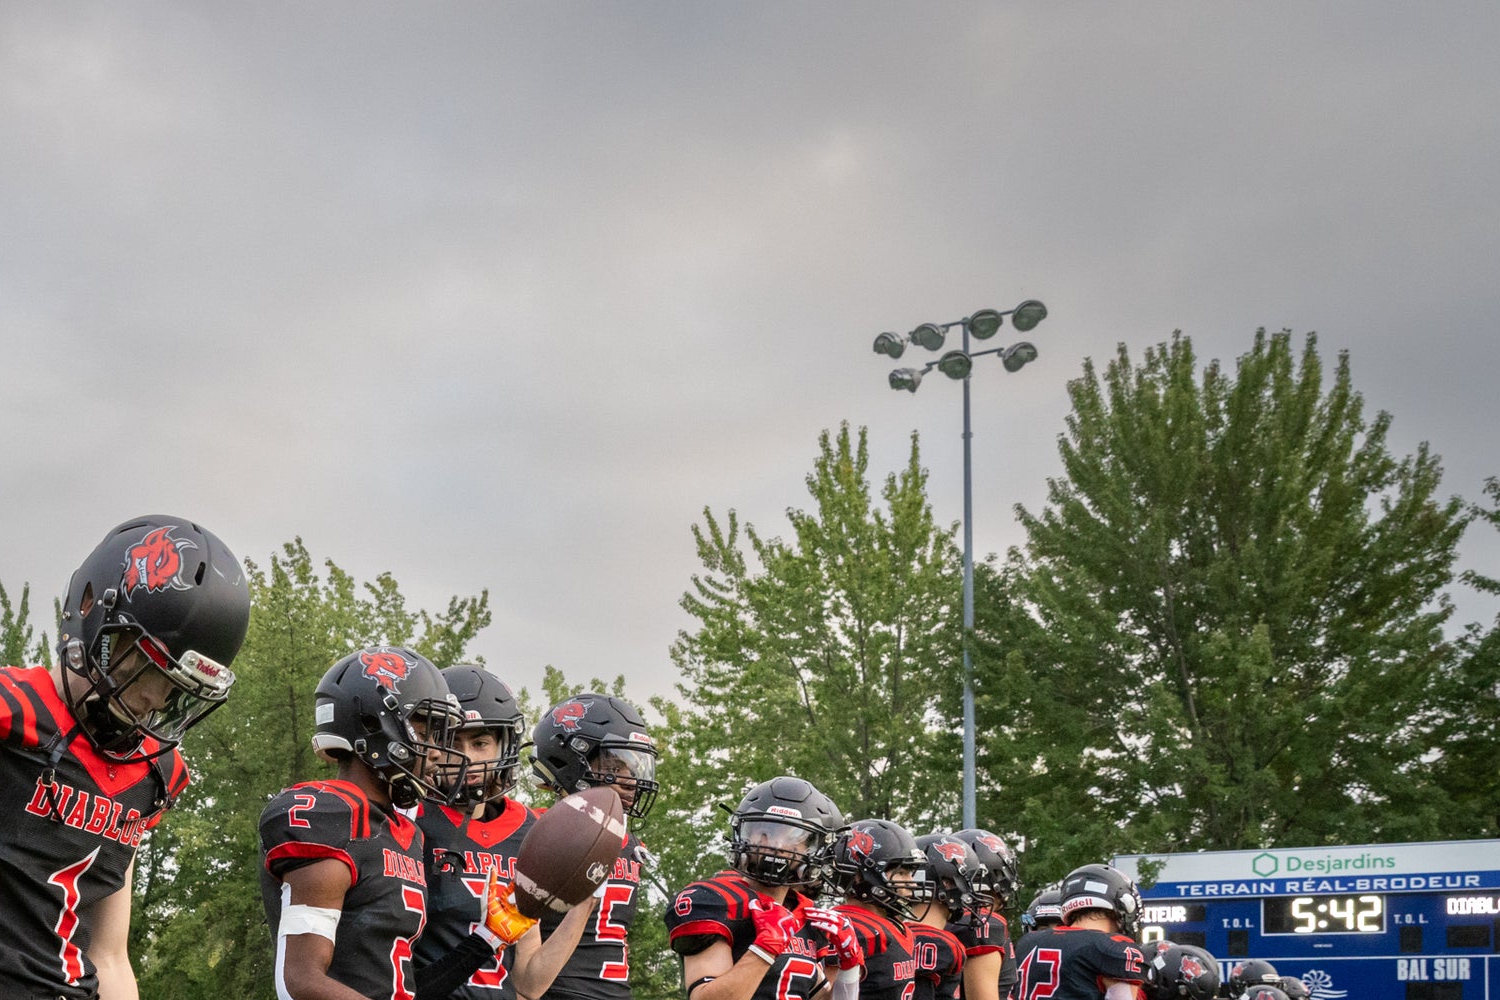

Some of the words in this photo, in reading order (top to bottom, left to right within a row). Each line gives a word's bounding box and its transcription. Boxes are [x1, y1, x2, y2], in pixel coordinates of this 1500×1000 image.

[101, 634, 110, 672] Riddel
[25, 776, 150, 848] DIABLOS
[289, 795, 316, 828] 2
[383, 848, 427, 888] DIABL
[433, 848, 518, 879] DABL
[1287, 853, 1396, 874] Desjardins
[1176, 882, 1275, 896] TERRAIN
[1285, 875, 1481, 893] RÉAL-BRODEUR
[47, 845, 101, 986] 1
[674, 889, 697, 916] 6
[1062, 898, 1093, 913] Riddell
[1140, 906, 1187, 923] ITEUR
[1291, 895, 1382, 934] 5:42
[1447, 897, 1500, 914] DIABL
[595, 884, 635, 982] 5
[914, 942, 938, 970] 10
[1124, 946, 1145, 973] 12
[1397, 959, 1429, 981] BAL
[1433, 958, 1471, 980] SUR
